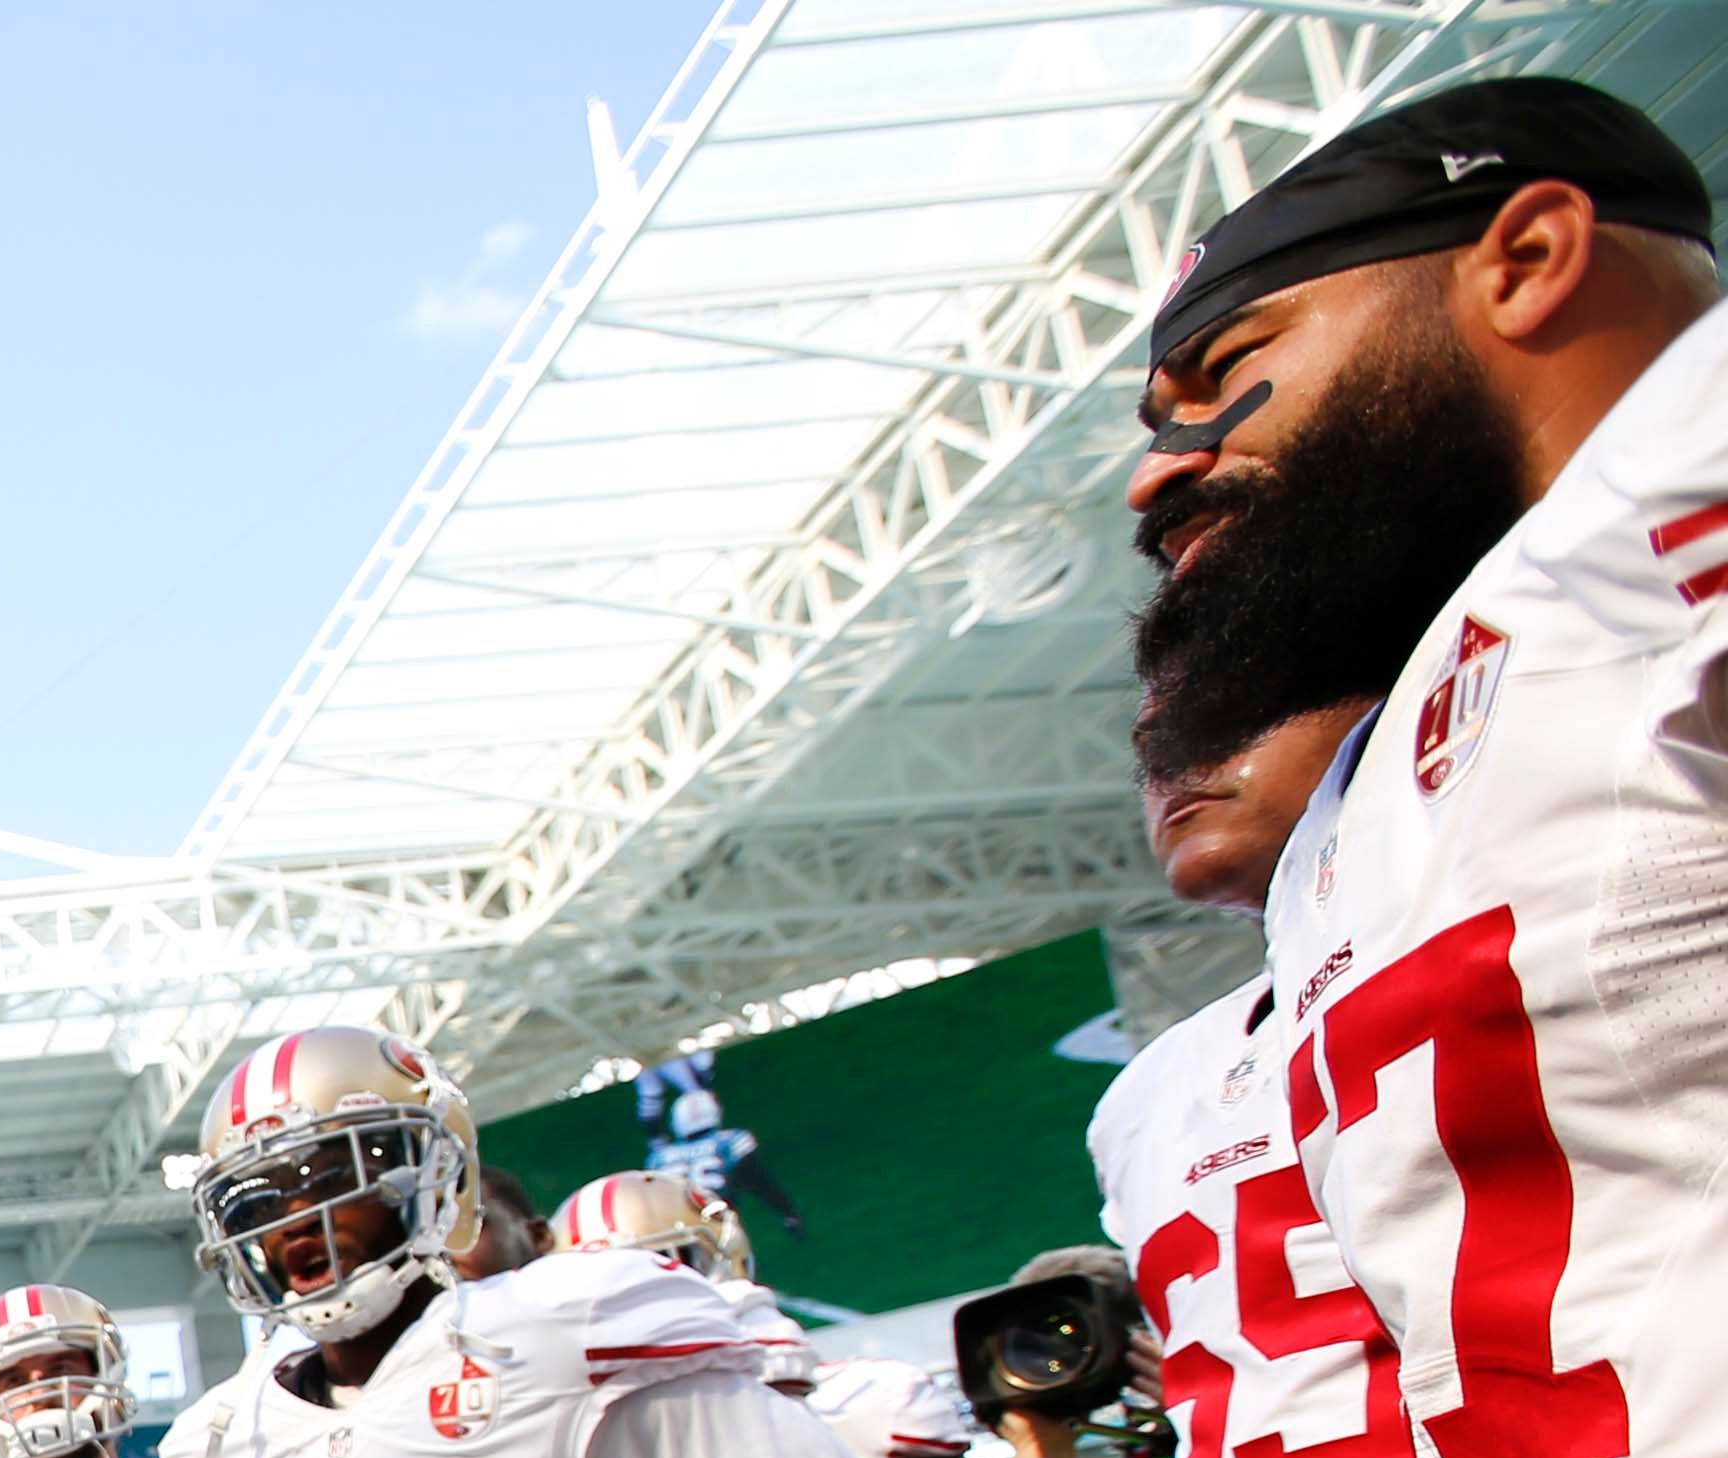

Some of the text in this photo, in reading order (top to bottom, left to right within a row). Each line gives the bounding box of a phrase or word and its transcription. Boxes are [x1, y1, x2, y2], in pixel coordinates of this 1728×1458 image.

[1296, 936, 1354, 1024] 49ERS
[1183, 1134, 1271, 1186] 49ERS
[434, 1383, 482, 1415] 70
